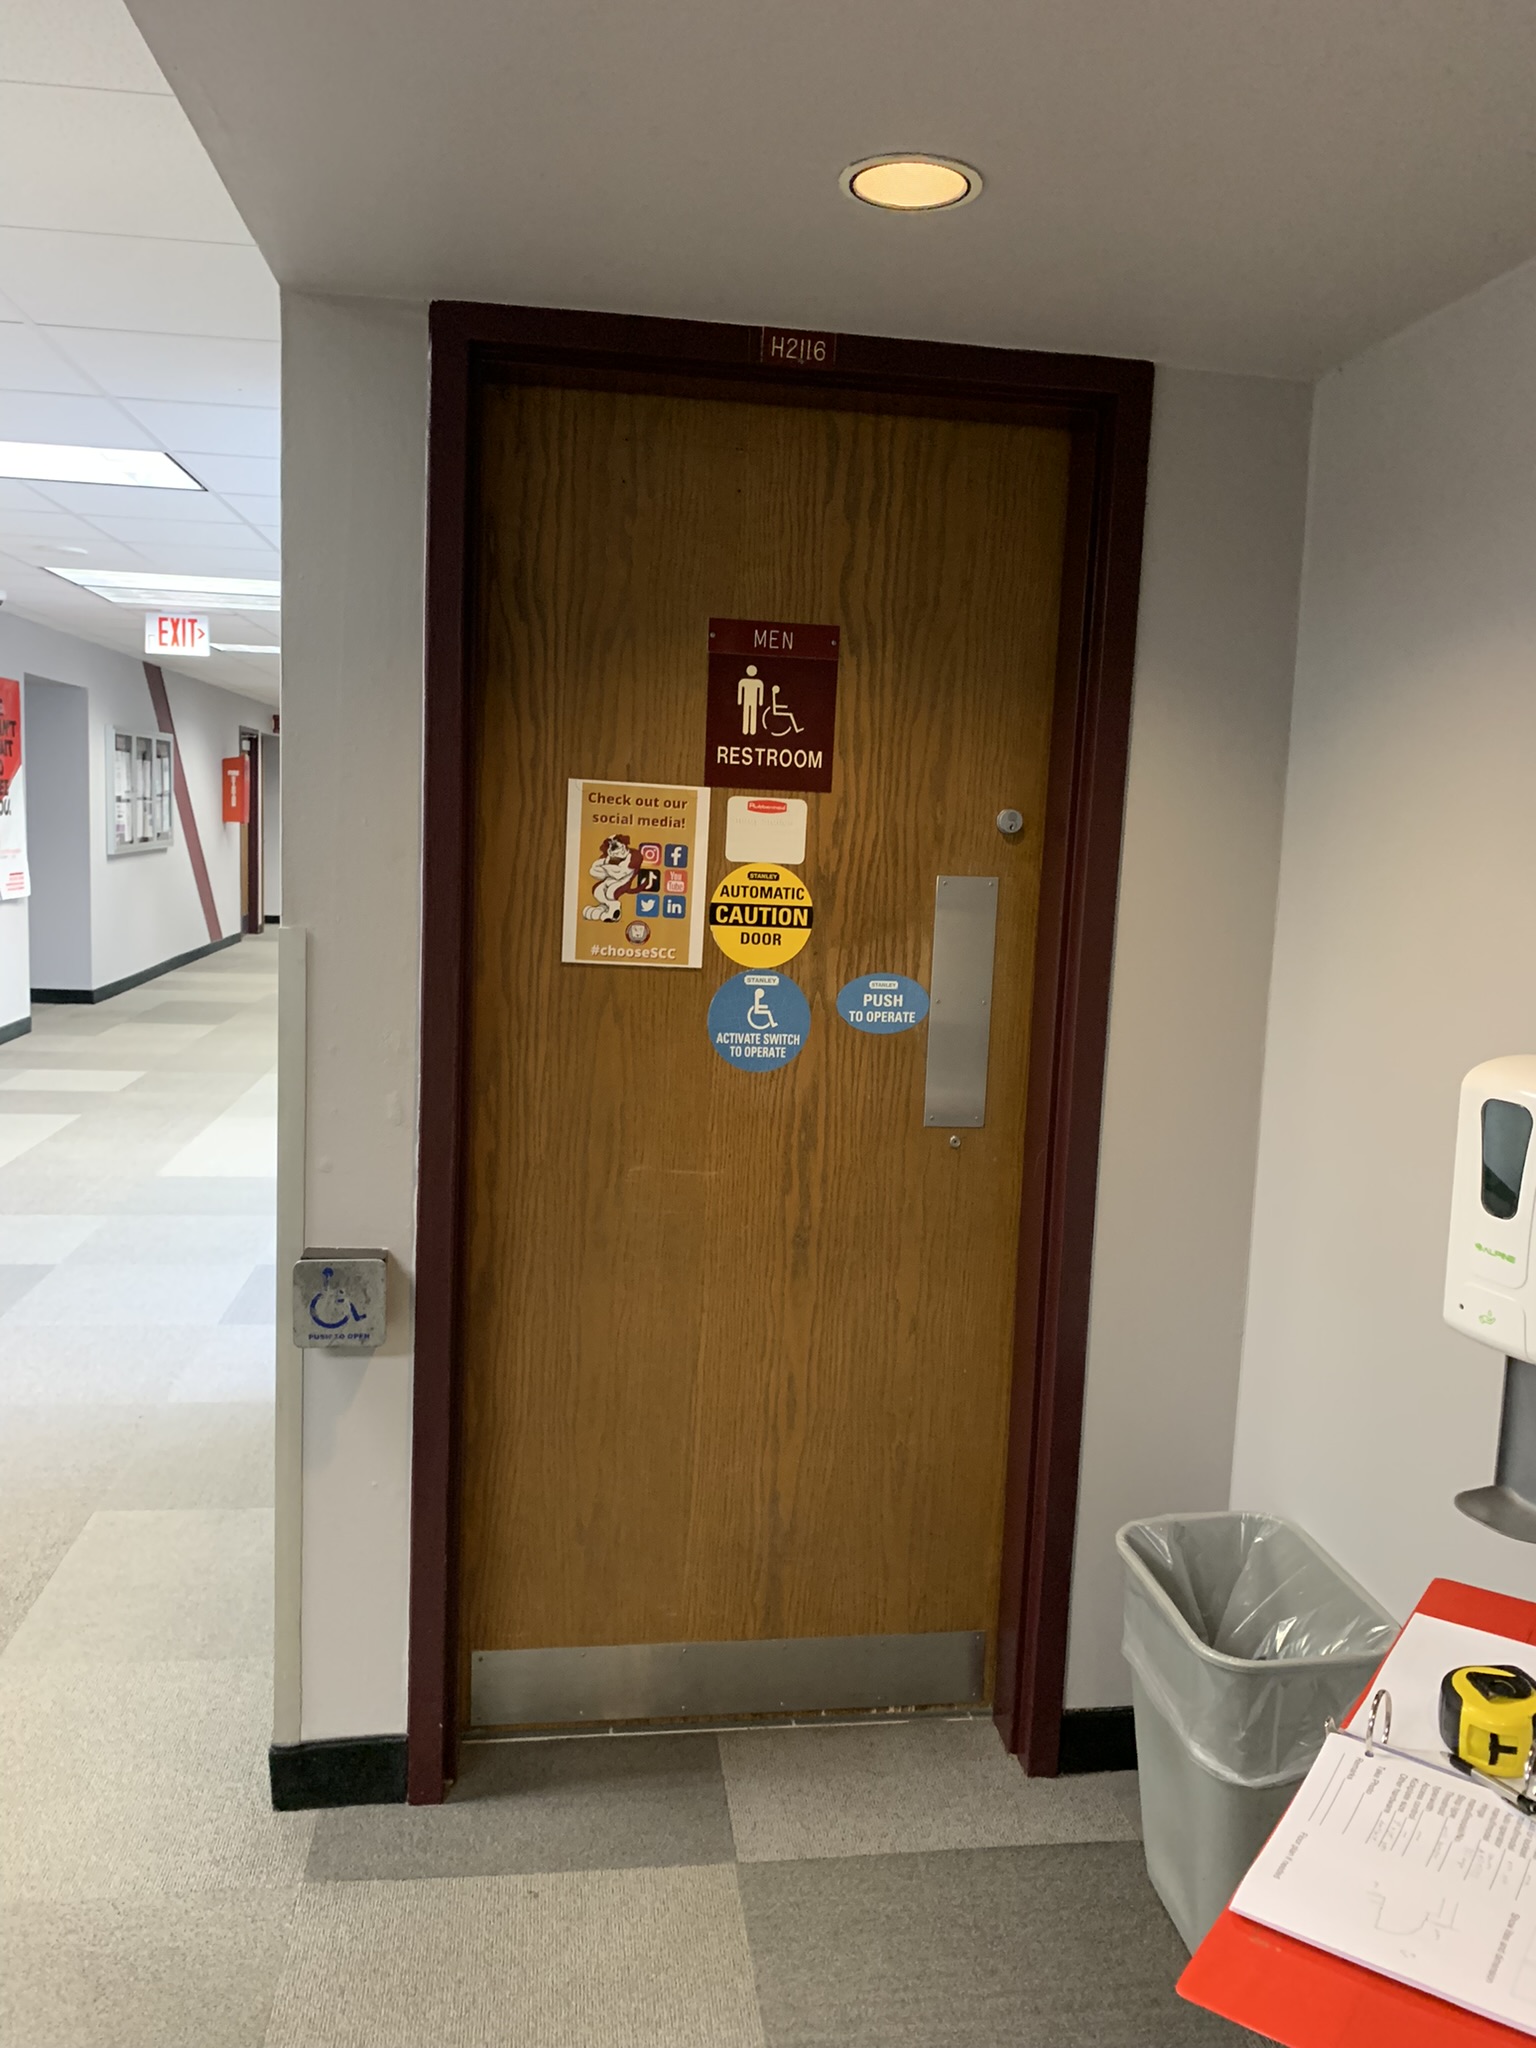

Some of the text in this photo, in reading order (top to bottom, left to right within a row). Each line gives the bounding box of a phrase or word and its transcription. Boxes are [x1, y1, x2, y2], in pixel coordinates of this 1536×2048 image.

[771, 336, 826, 361] H2116
[158, 617, 198, 647] EXIT
[754, 629, 794, 650] MEN
[716, 746, 823, 769] RESTROOM
[588, 792, 688, 809] Check out our
[592, 813, 686, 828] social media!
[670, 871, 682, 881] You
[720, 885, 805, 901] AUTOMATIC
[715, 905, 808, 926] CAUTION
[740, 932, 782, 946] DOOR
[591, 945, 676, 959] #chooseSCC
[863, 994, 904, 1008] PUSH
[849, 1010, 916, 1023] TO OPERATE
[716, 1032, 801, 1046] ACTIVATE SWITCH
[730, 1046, 787, 1058] TO OPERATE
[308, 1333, 333, 1341] PUSH
